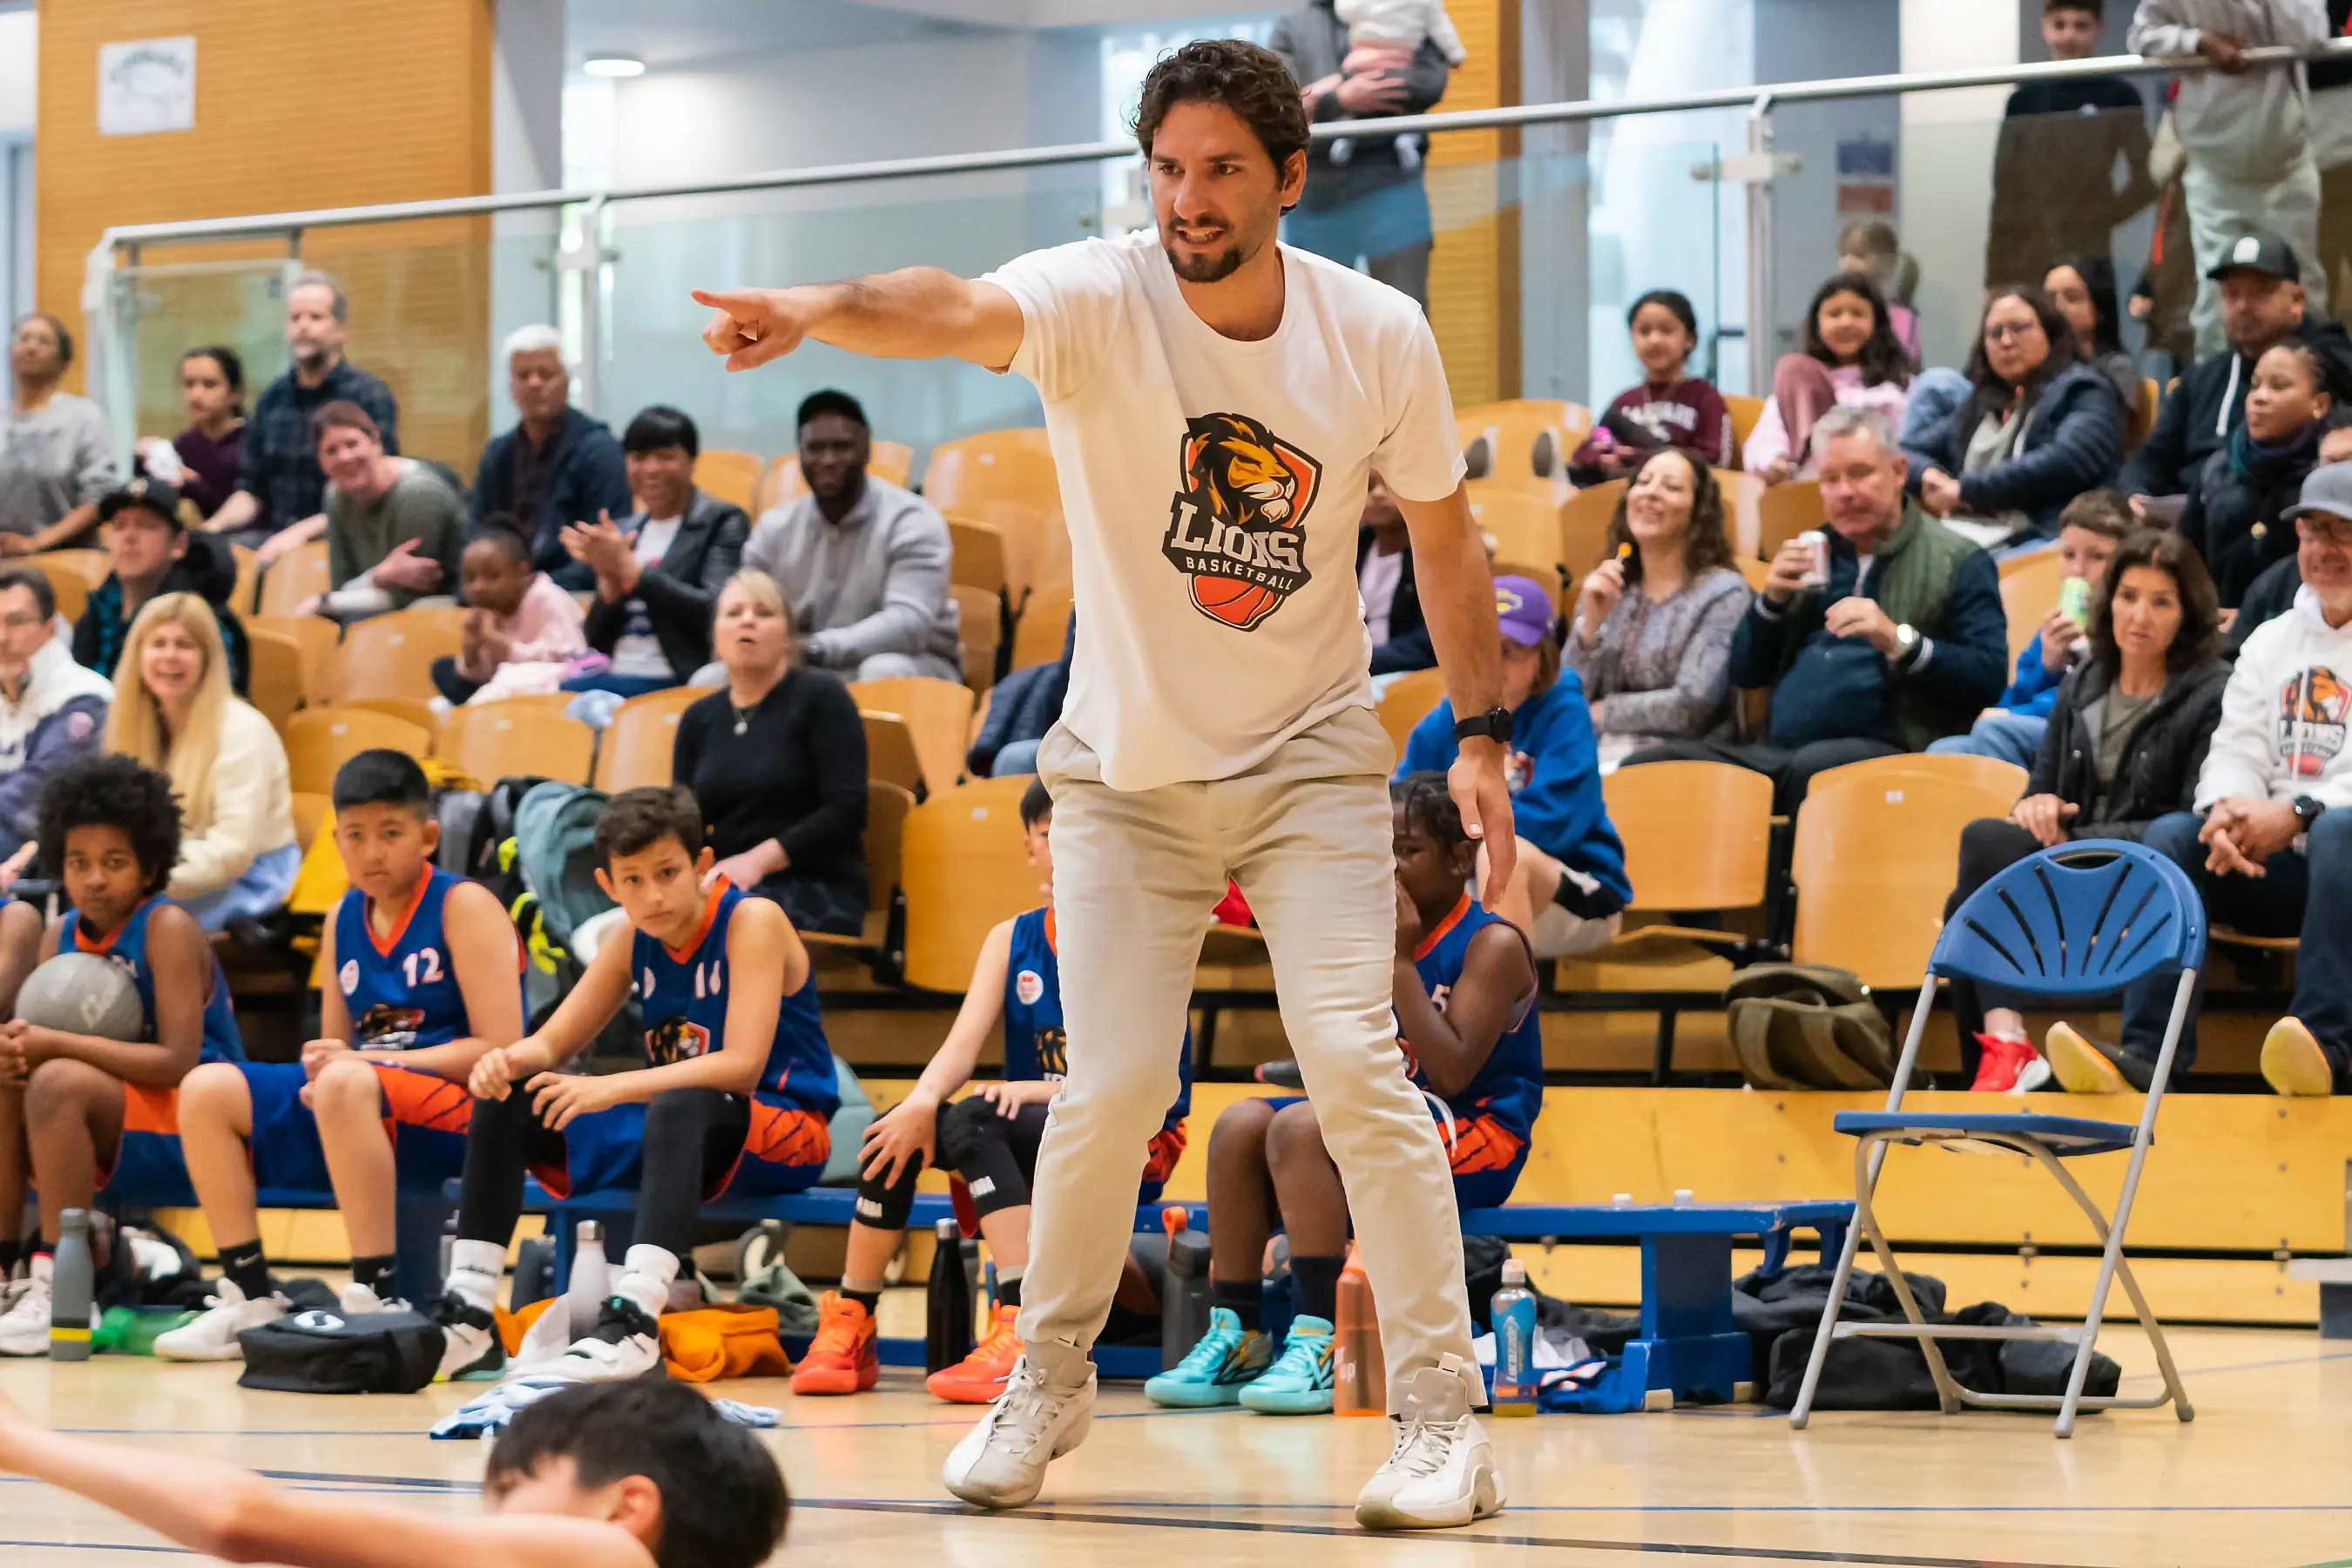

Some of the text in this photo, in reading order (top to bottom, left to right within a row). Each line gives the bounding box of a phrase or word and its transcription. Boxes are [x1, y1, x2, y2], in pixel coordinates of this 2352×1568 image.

[1171, 501, 1301, 572] LIONS
[1186, 556, 1293, 591] BASKETBALL
[402, 947, 445, 988] 12
